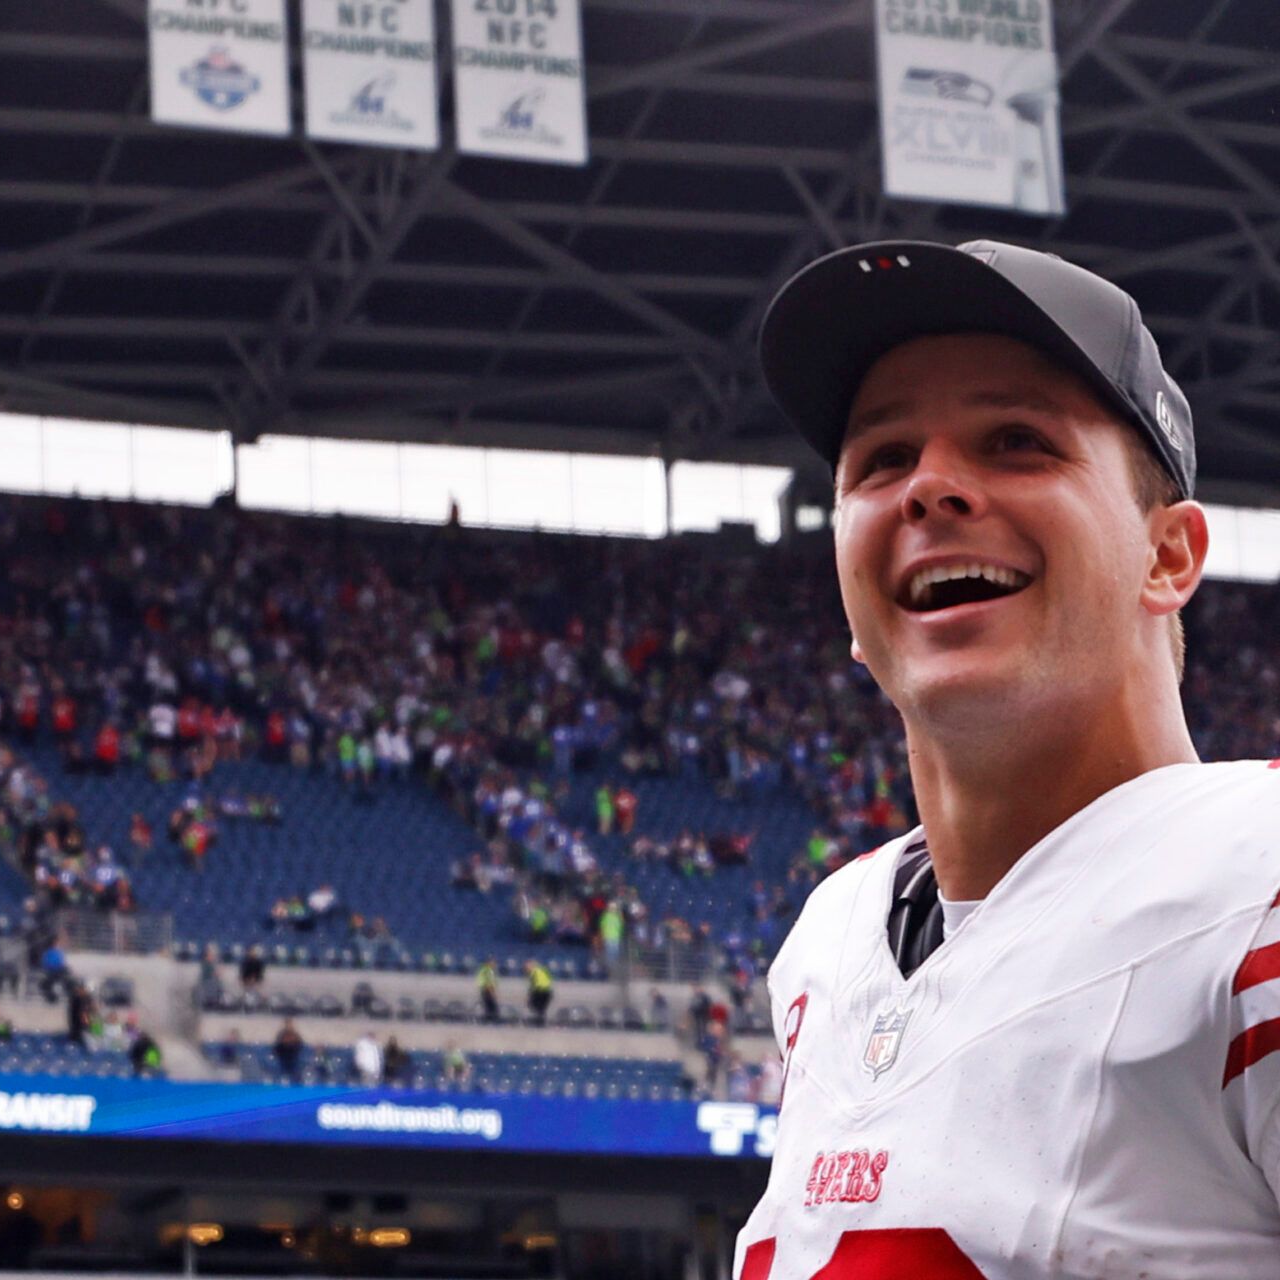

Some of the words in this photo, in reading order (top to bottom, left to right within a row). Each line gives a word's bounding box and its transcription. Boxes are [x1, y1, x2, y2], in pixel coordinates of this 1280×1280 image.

[154, 11, 282, 41] CHAMPIONS
[337, 3, 399, 33] NFC
[885, 9, 1043, 50] CHAMPIONS
[308, 30, 433, 61] CHAMPIONS
[488, 19, 547, 49] NFC
[457, 46, 579, 77] CHAMPIONS
[869, 1034, 897, 1066] NFL
[317, 1102, 502, 1140] soundtransit.org
[804, 1148, 888, 1207] 49ERS
